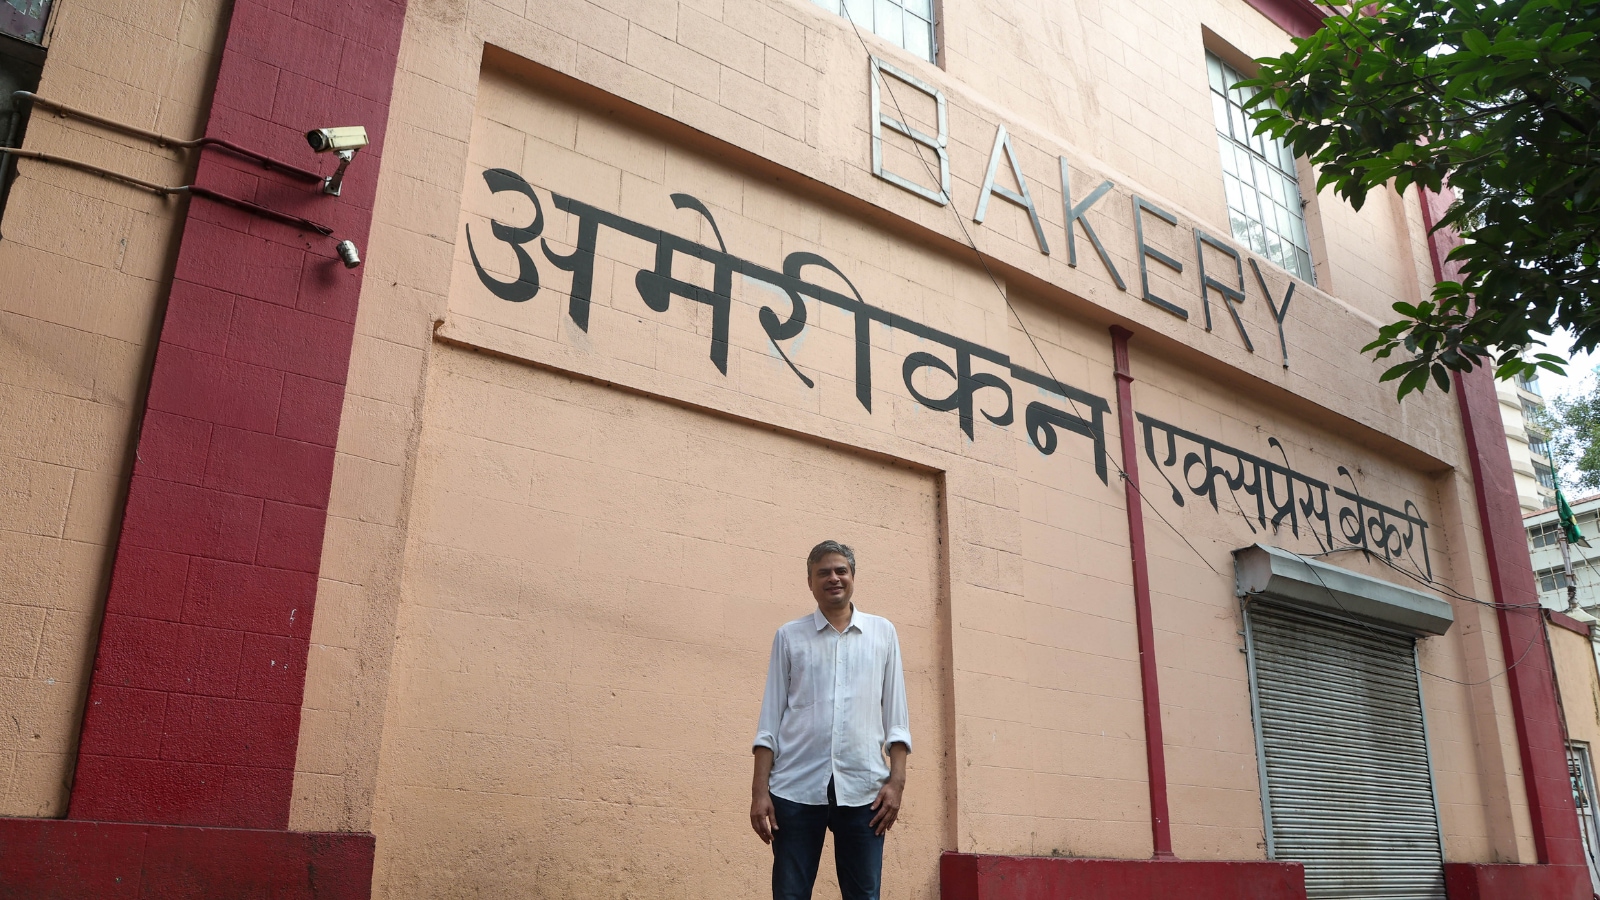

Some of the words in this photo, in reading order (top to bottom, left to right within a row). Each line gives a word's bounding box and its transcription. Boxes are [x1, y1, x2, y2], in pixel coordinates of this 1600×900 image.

[466, 168, 1112, 486] अमेरीकन
[1135, 411, 1334, 556] एक्सप्रेस
[1333, 466, 1432, 583] बेकरी
[870, 55, 1295, 368] BAKERY
